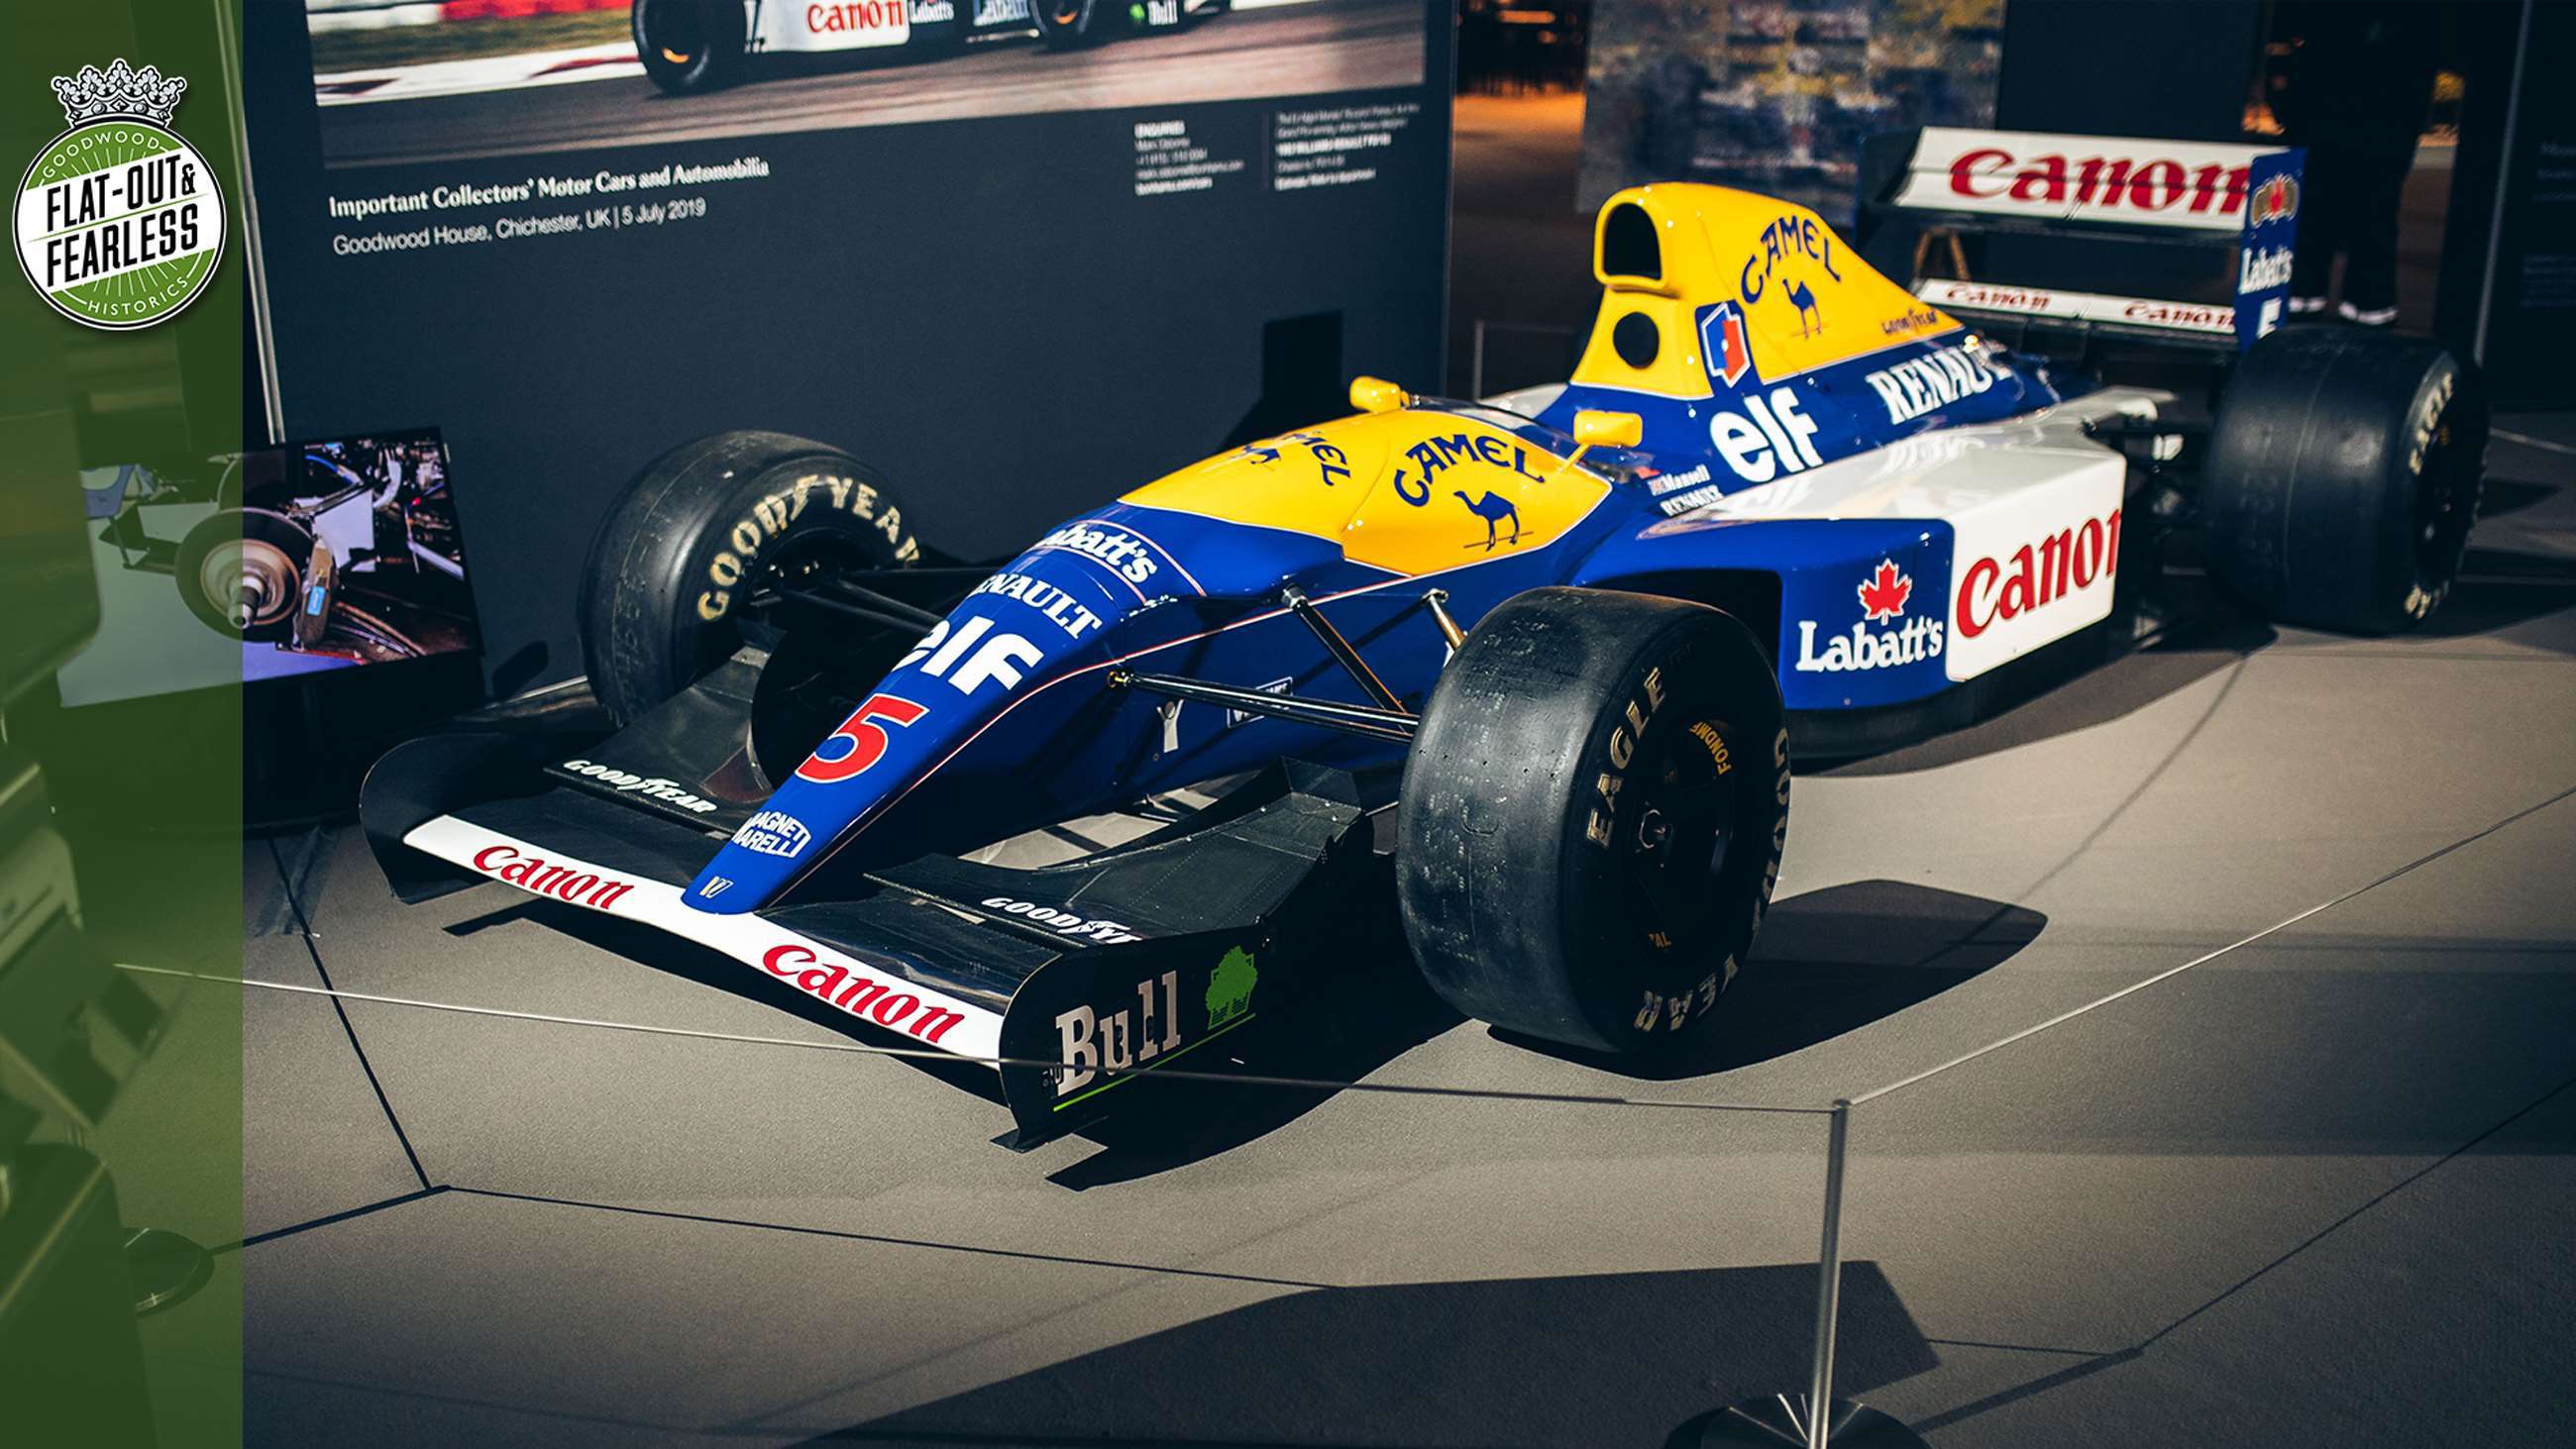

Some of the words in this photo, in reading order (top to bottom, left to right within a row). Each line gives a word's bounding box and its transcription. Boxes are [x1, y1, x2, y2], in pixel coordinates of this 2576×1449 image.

[329, 191, 429, 221] Important
[538, 175, 593, 198] Motor
[595, 170, 637, 193] Cars
[638, 164, 671, 189] and
[673, 155, 770, 185] Automobilia
[1949, 148, 2251, 217] Canon
[333, 227, 430, 256] Goodwood
[586, 206, 611, 230] UK
[621, 204, 634, 226] 5
[635, 202, 667, 225] July
[668, 196, 706, 220] 2019
[1741, 215, 1842, 305] CAMEL
[1946, 280, 2050, 311] Canon
[1710, 385, 1823, 483] elf
[1393, 434, 1546, 508] CAMEL
[1795, 615, 1943, 673] Labatt's
[795, 693, 929, 783] 5
[1586, 666, 1666, 850] EAGLE
[563, 759, 718, 813] GOODYEAR
[473, 845, 635, 910] Canon
[762, 944, 965, 1045] Canon
[1055, 970, 1181, 1097] Bull
